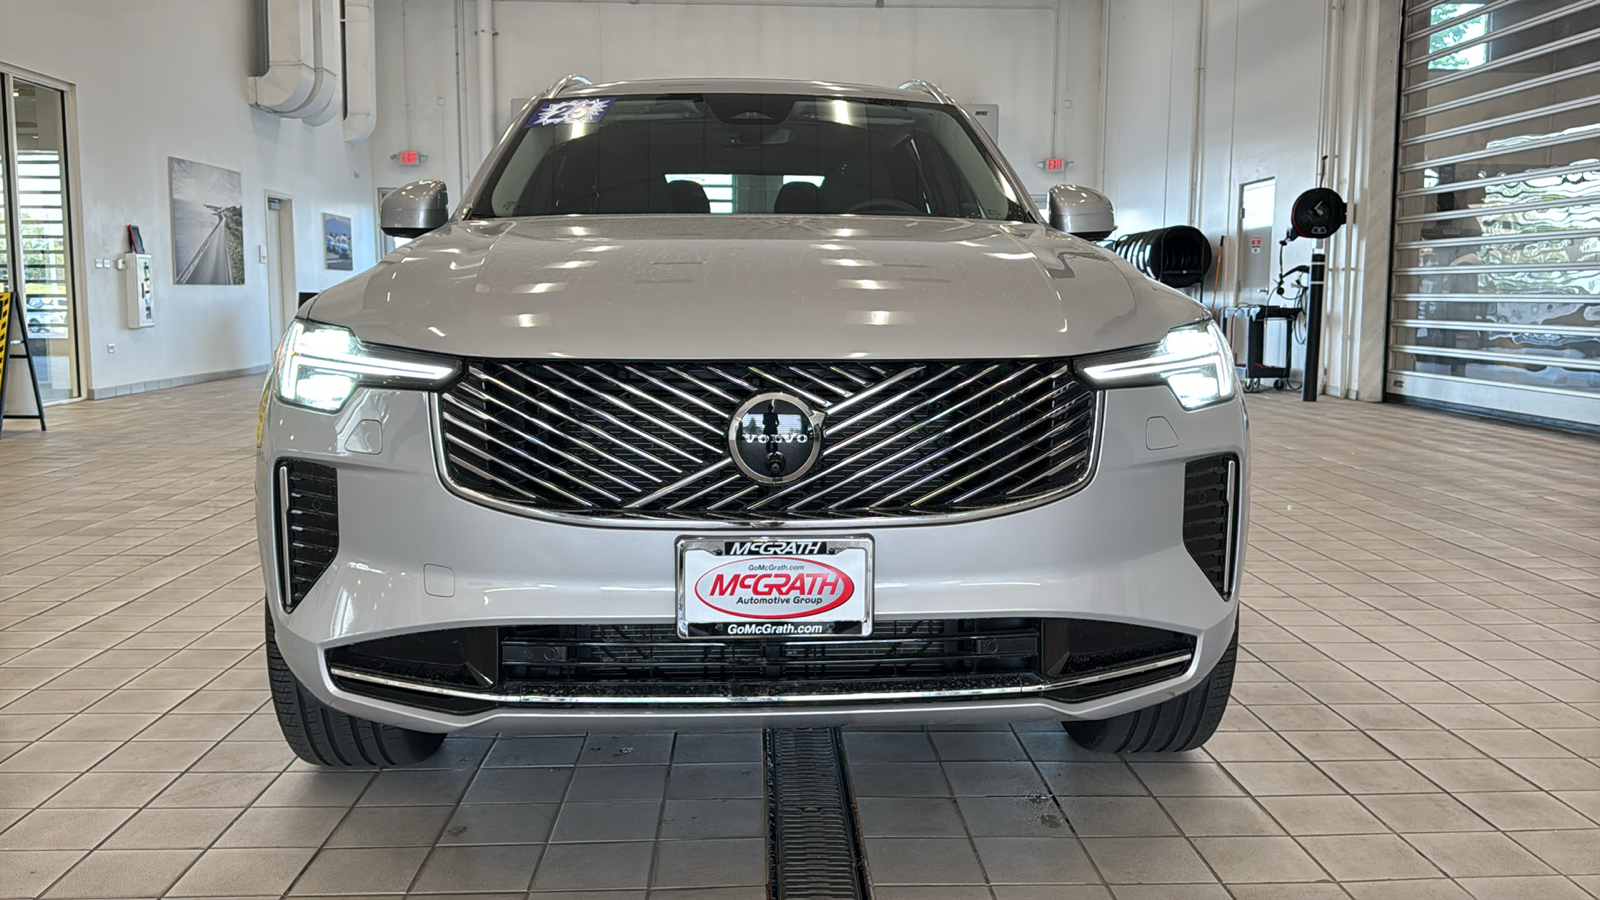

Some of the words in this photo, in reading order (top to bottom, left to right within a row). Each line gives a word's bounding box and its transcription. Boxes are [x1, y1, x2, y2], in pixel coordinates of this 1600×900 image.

[401, 151, 417, 164] EXIT
[1047, 158, 1062, 170] EXIT
[742, 434, 808, 443] VOLVO
[748, 564, 804, 572] GoMcGrath.com
[736, 596, 790, 605] Automotive
[792, 596, 823, 606] Group
[727, 623, 823, 635] GoMcGrath.com
